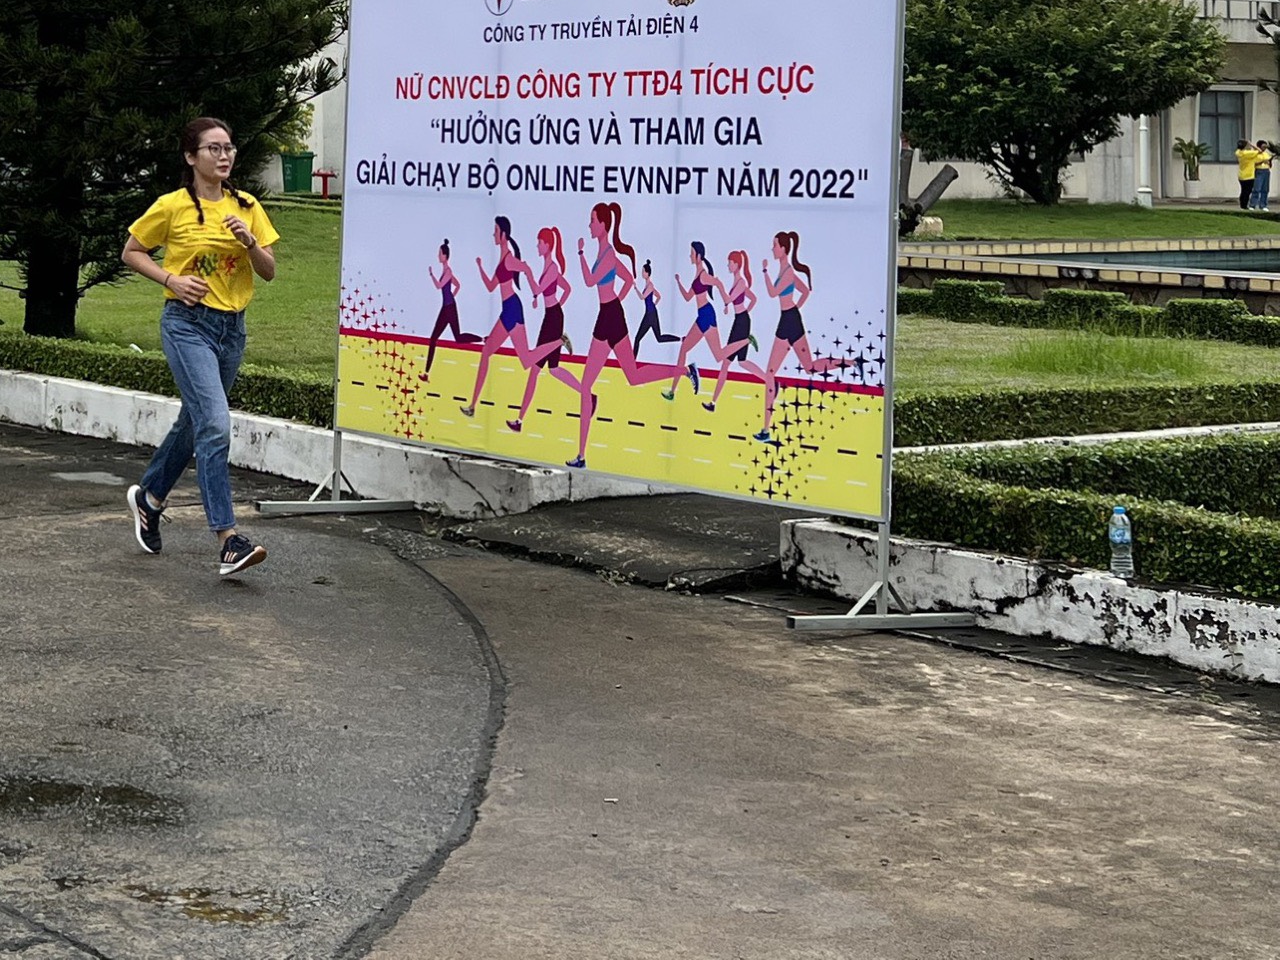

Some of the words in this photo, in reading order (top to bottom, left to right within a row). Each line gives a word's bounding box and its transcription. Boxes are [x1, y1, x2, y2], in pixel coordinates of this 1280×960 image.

[483, 23, 524, 42] CÔNG
[529, 24, 547, 40] TY
[551, 15, 612, 40] TRUYỀN
[617, 14, 641, 36] TẢI
[646, 13, 684, 38] ĐIỆN
[690, 16, 699, 33] 4
[396, 72, 423, 99] NỮ
[428, 75, 510, 99] CNVCLĐ
[516, 68, 581, 99] CÔNG
[588, 72, 617, 98] TY
[624, 70, 682, 96] TTĐ4
[691, 62, 748, 95] TÍCH
[757, 62, 814, 100] CỰC
[529, 114, 580, 145] ỨNG
[589, 111, 621, 145] VÀ
[630, 117, 704, 145] THAM
[714, 116, 762, 146] GIA
[356, 153, 396, 185] GIẢI
[403, 161, 460, 191] CHẠY
[468, 157, 499, 195] BỘ
[507, 164, 594, 192] ONLINE
[604, 166, 709, 195] EVNNPT
[717, 162, 779, 197] NĂM
